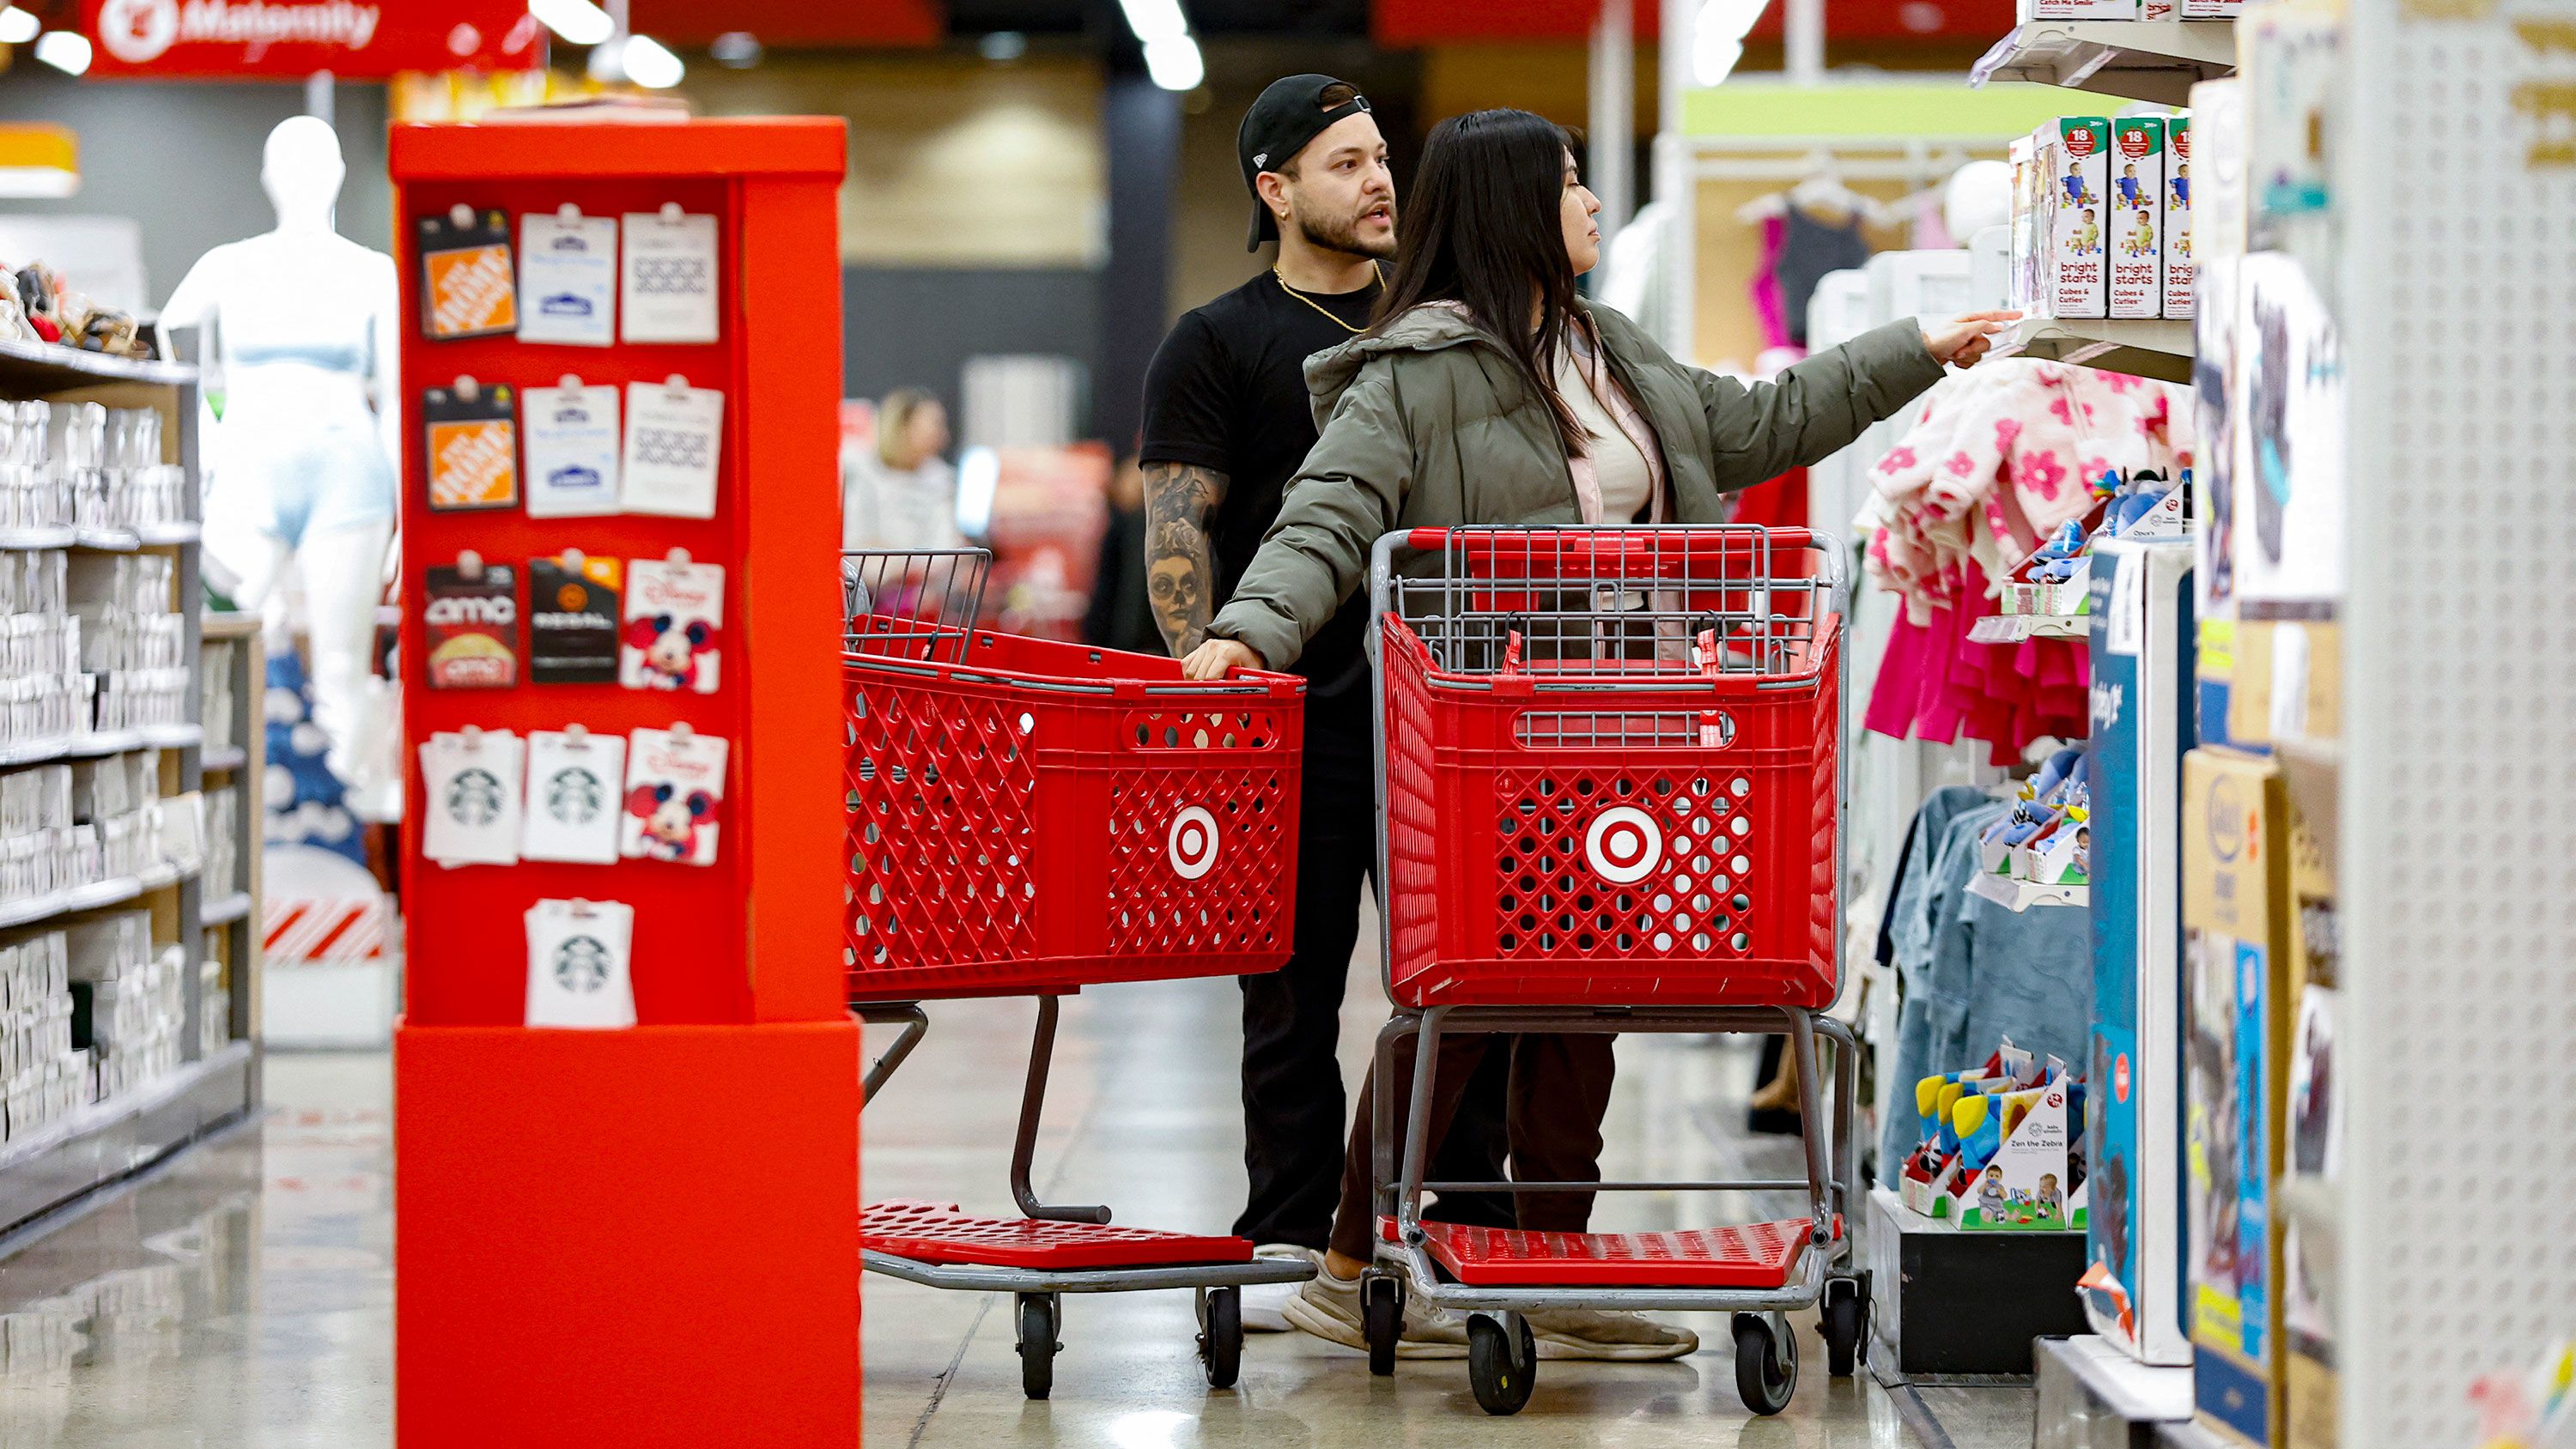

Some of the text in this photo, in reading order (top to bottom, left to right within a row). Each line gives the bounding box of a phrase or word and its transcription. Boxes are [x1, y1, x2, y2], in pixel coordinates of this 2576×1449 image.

[182, 0, 380, 50] Maternity
[2072, 130, 2088, 142] 18
[2126, 130, 2143, 142] 18
[2061, 261, 2098, 275] bright
[2115, 263, 2153, 276] bright
[2169, 264, 2192, 276] brig
[2060, 273, 2098, 283] starts
[2115, 275, 2153, 285] starts
[2169, 275, 2193, 285] star
[424, 596, 515, 626] amc
